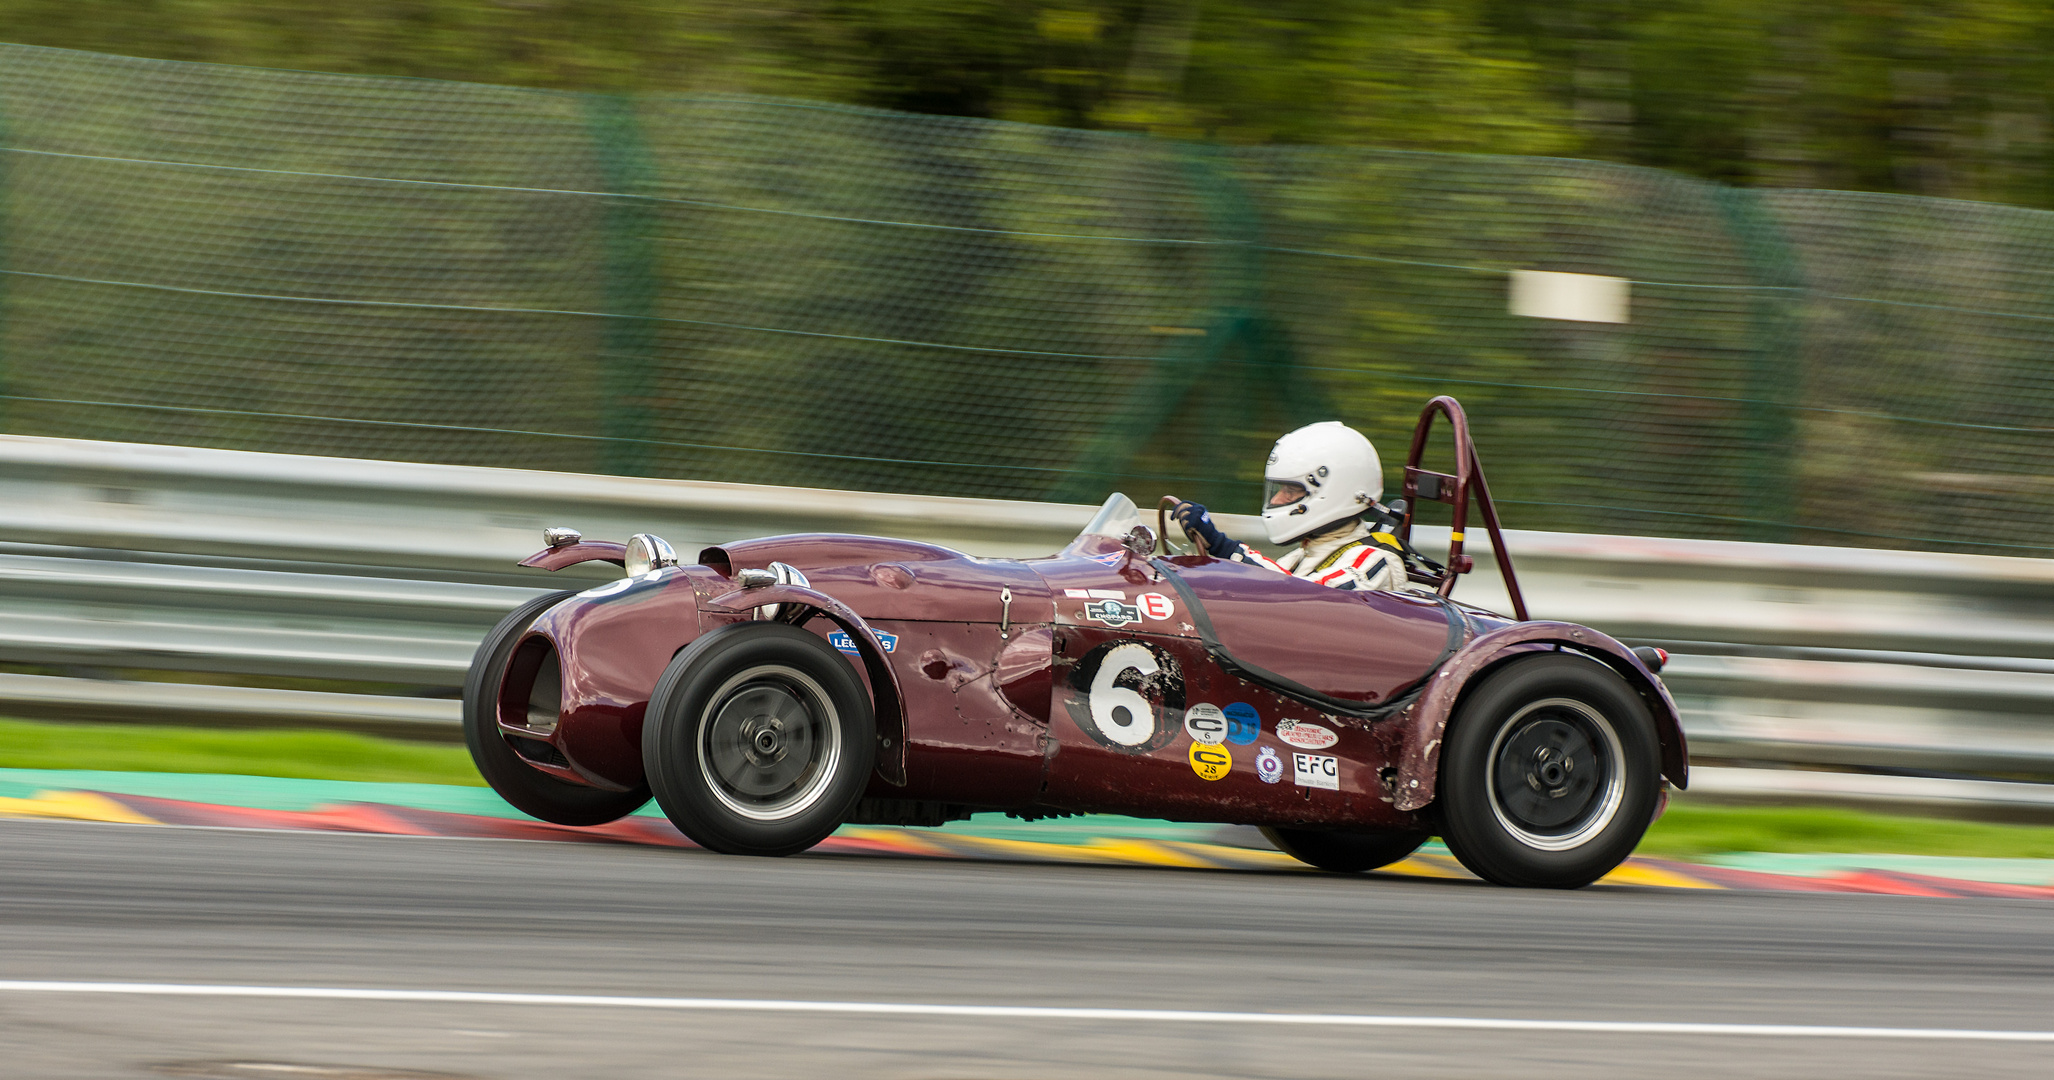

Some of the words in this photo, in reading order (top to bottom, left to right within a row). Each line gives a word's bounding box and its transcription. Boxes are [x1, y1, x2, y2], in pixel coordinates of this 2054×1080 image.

[1145, 595, 1166, 617] E
[1089, 643, 1160, 746] 6
[1189, 718, 1223, 732] C
[1204, 732, 1212, 740] 6
[1194, 751, 1227, 766] C
[1296, 755, 1336, 776] EFG
[1204, 764, 1217, 775] 28
